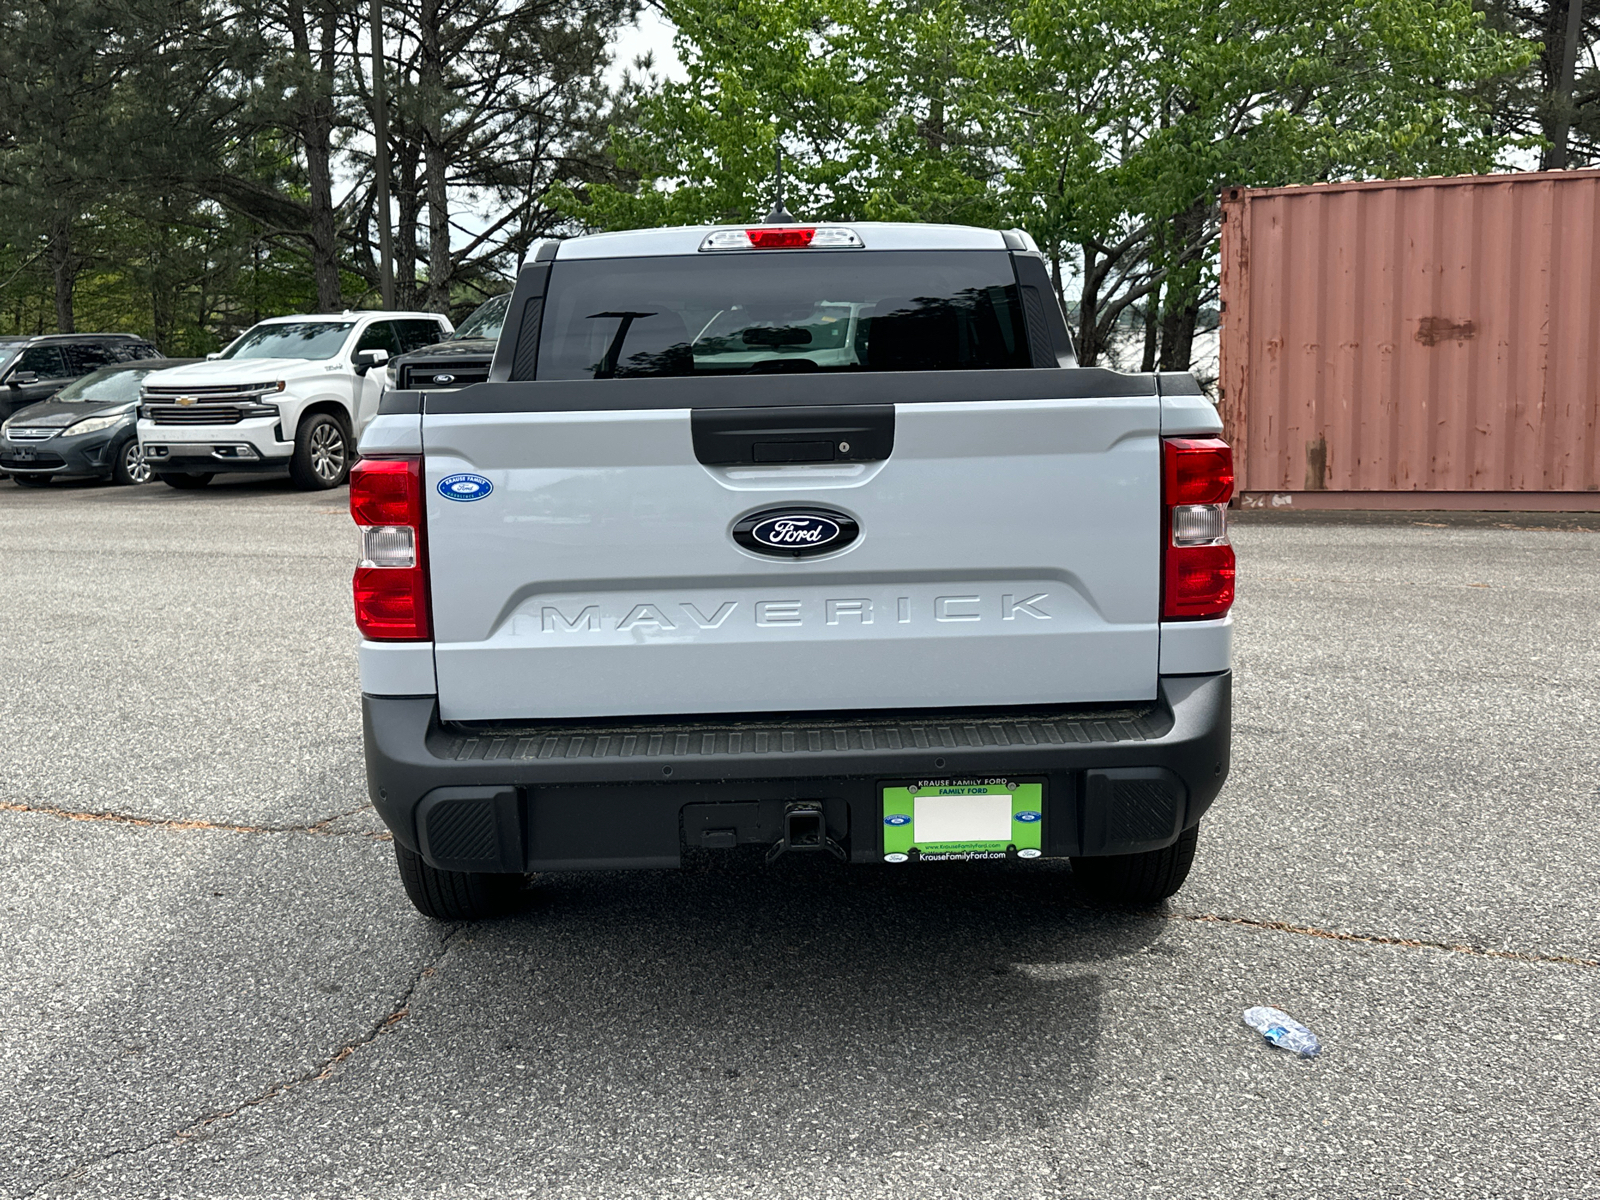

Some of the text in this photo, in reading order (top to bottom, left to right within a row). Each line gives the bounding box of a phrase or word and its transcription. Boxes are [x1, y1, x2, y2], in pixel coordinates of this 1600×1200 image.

[445, 476, 486, 485] KRAUSE FAMILY
[456, 483, 474, 491] Ford
[769, 520, 823, 542] Ford
[541, 593, 1053, 633] MAVERICK
[919, 851, 1006, 861] KrauseFamilyFord.com
